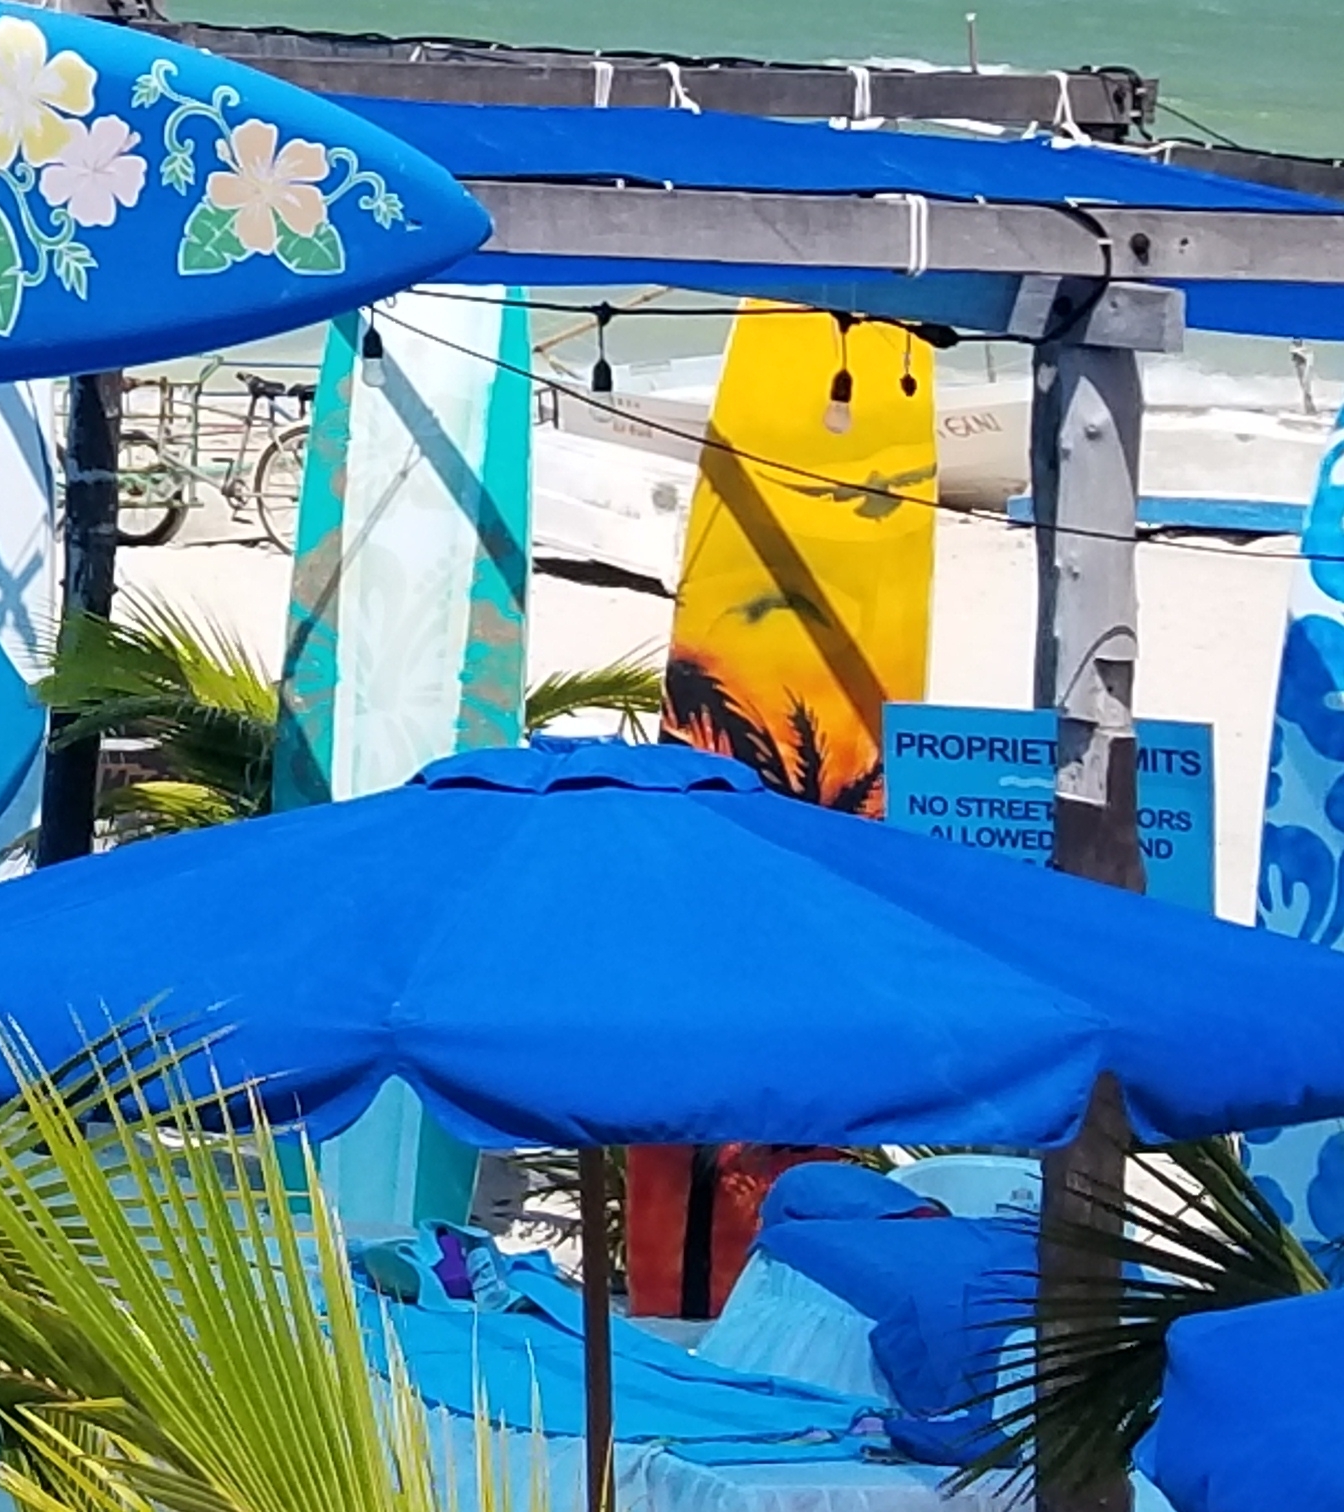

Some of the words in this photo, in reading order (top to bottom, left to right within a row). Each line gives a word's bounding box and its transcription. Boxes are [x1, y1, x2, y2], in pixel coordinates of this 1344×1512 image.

[896, 732, 1058, 765] PROPRIET
[1136, 747, 1202, 776] MITS
[909, 795, 948, 816] NO
[955, 796, 1054, 821] STREET
